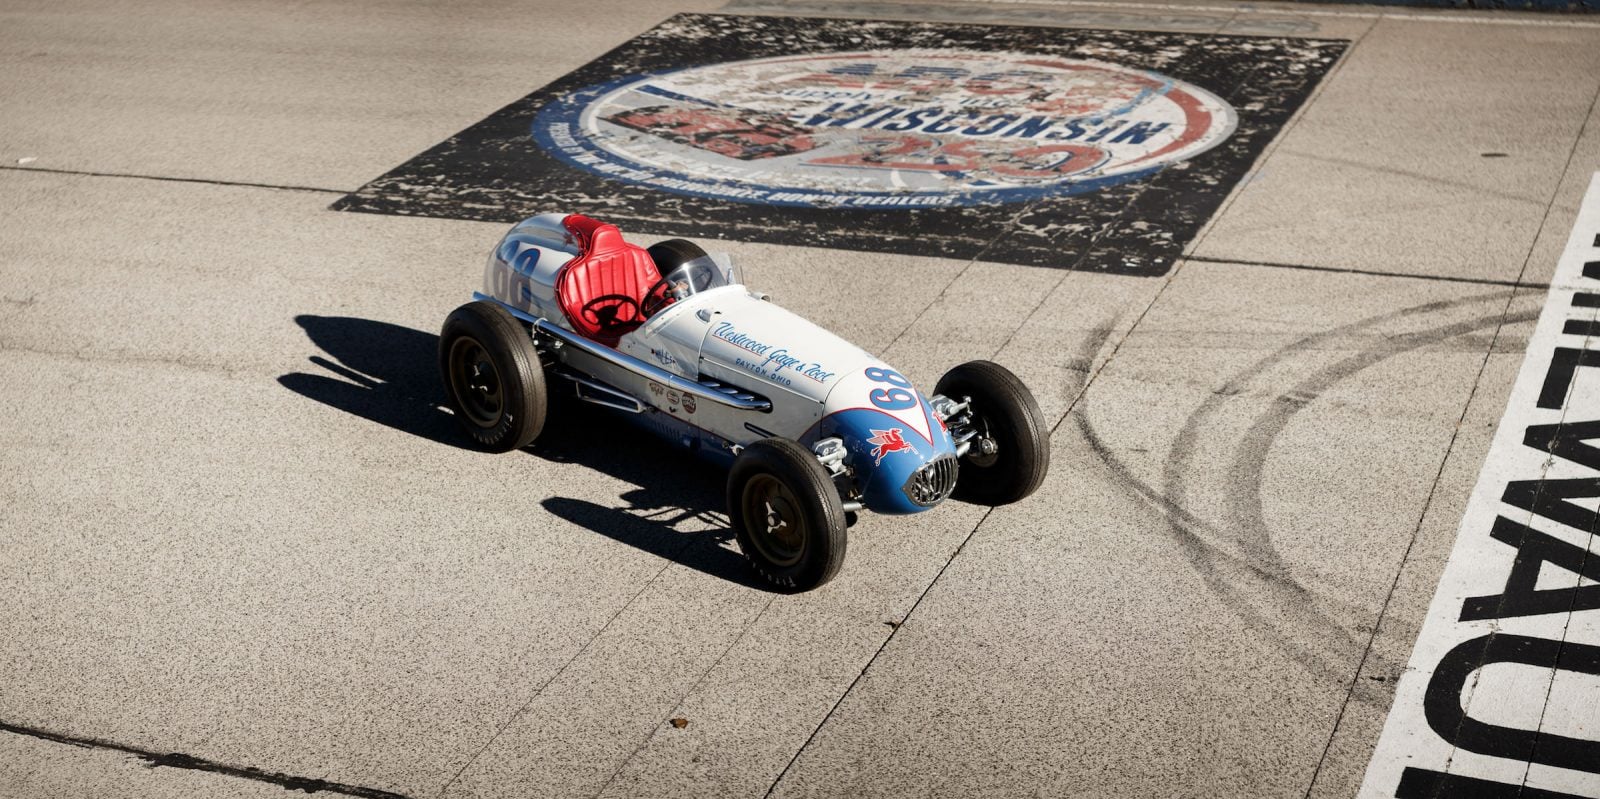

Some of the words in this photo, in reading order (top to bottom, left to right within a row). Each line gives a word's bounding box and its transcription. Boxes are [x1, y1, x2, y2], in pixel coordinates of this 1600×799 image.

[804, 101, 1172, 146] WISCONSIN
[871, 194, 955, 206] DEALERS
[713, 322, 772, 356] Westwood
[762, 349, 802, 373] Gage
[796, 364, 808, 374] &
[806, 364, 838, 384] Tool
[771, 374, 793, 387] OHIO
[864, 366, 917, 411] 68
